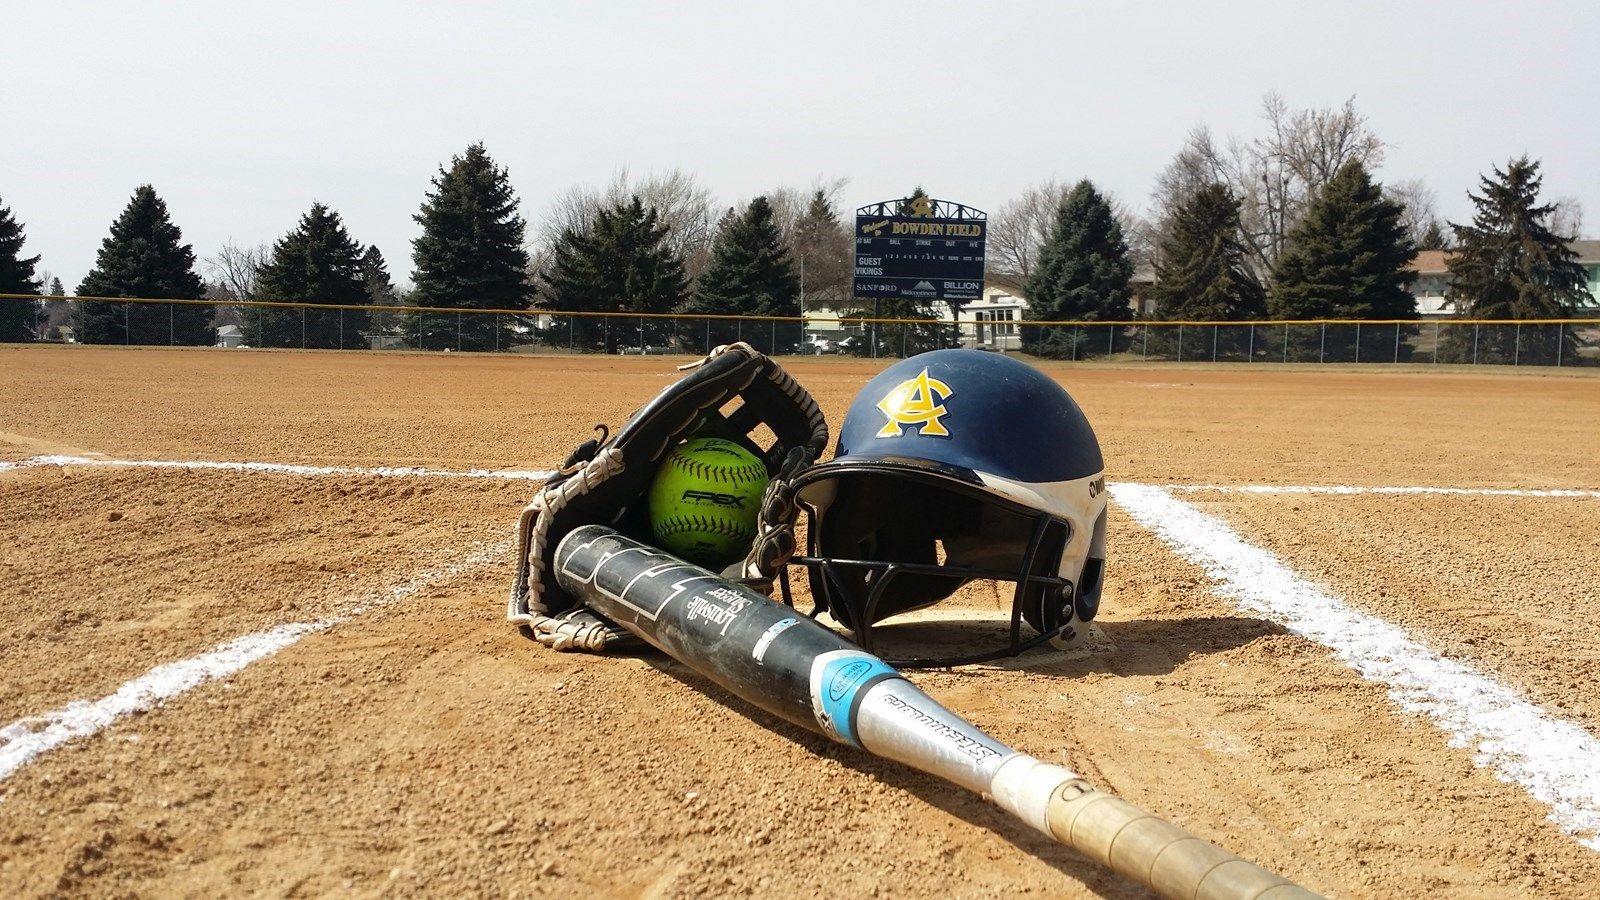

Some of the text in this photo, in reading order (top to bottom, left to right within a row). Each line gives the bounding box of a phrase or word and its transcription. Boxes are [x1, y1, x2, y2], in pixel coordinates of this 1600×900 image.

[891, 222, 982, 237] BOWDEN FIELD
[858, 256, 882, 266] GUEST
[855, 267, 883, 276] VIKINGS
[856, 283, 897, 292] SANFORD
[943, 281, 979, 290] BILLION
[708, 587, 754, 617] Slugger
[686, 594, 738, 637] Louisville
